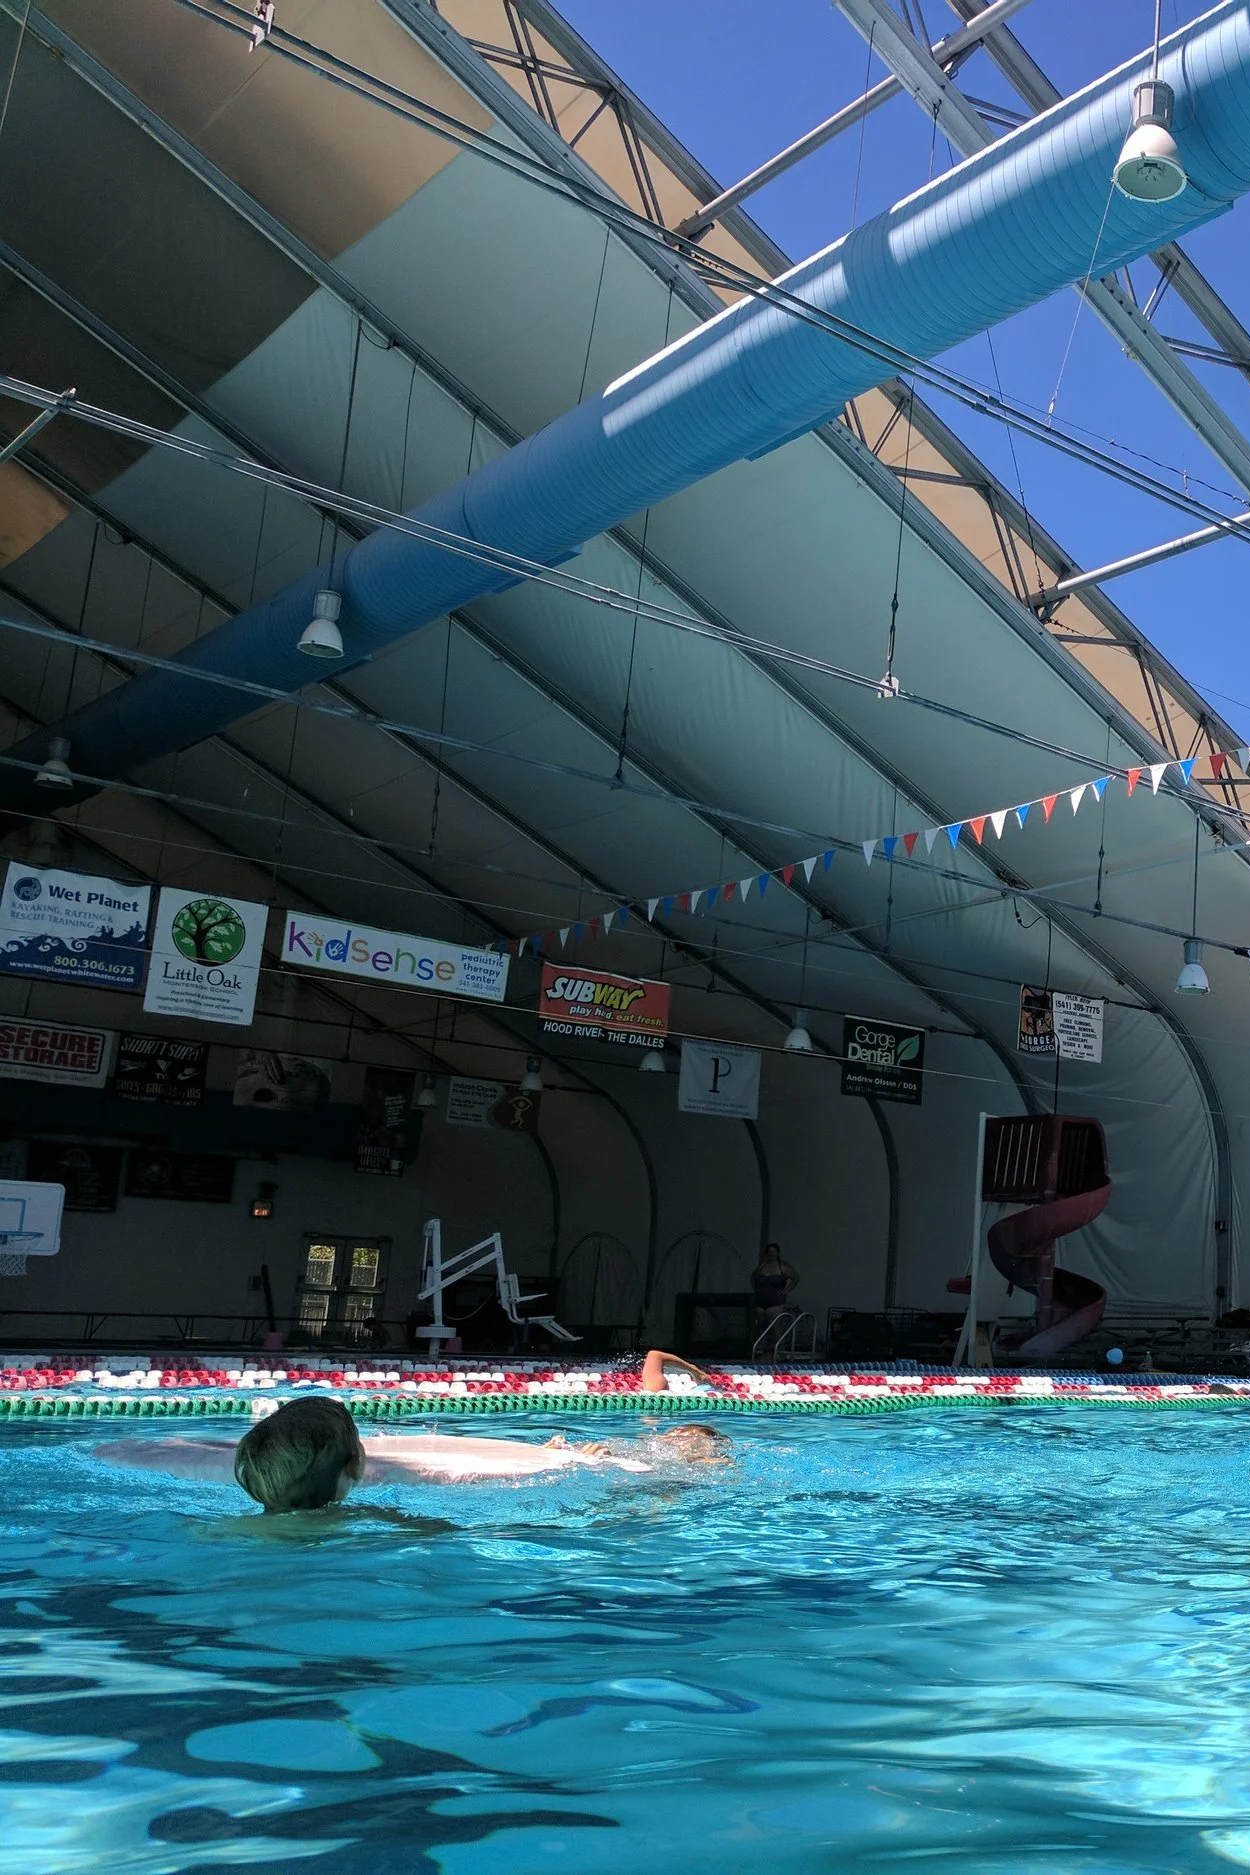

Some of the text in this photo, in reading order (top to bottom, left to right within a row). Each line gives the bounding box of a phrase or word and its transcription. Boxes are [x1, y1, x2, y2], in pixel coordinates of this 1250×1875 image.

[48, 885, 139, 912] Wet Planet
[10, 910, 94, 929] RESCUE TRAINING
[65, 909, 106, 921] RAFTING
[9, 960, 134, 983] www.wetplanetwhitewater.com
[54, 955, 135, 975] 800.306.1673
[163, 961, 242, 989] Little Oak
[463, 963, 501, 978] therapy
[465, 973, 496, 984] center
[209, 986, 239, 996] SCHOOL
[546, 976, 646, 1010] SUBWAY
[569, 1005, 592, 1016] play
[616, 1014, 635, 1023] eat
[637, 1015, 664, 1027] fresh.
[1055, 1000, 1072, 1011] (541)
[0, 1025, 100, 1054] SECURE
[543, 1021, 573, 1035] HOOD
[608, 1032, 627, 1044] THE
[628, 1035, 665, 1049] DALLES
[855, 1025, 896, 1051] Gorge
[0, 1043, 98, 1070] STORAGE
[848, 1042, 895, 1065] Dental
[1029, 1044, 1056, 1052] SURGEO
[708, 1055, 732, 1094] P
[846, 1074, 873, 1084] Andrew
[902, 1082, 917, 1091] DDS
[452, 1082, 497, 1093] Indian Creek
